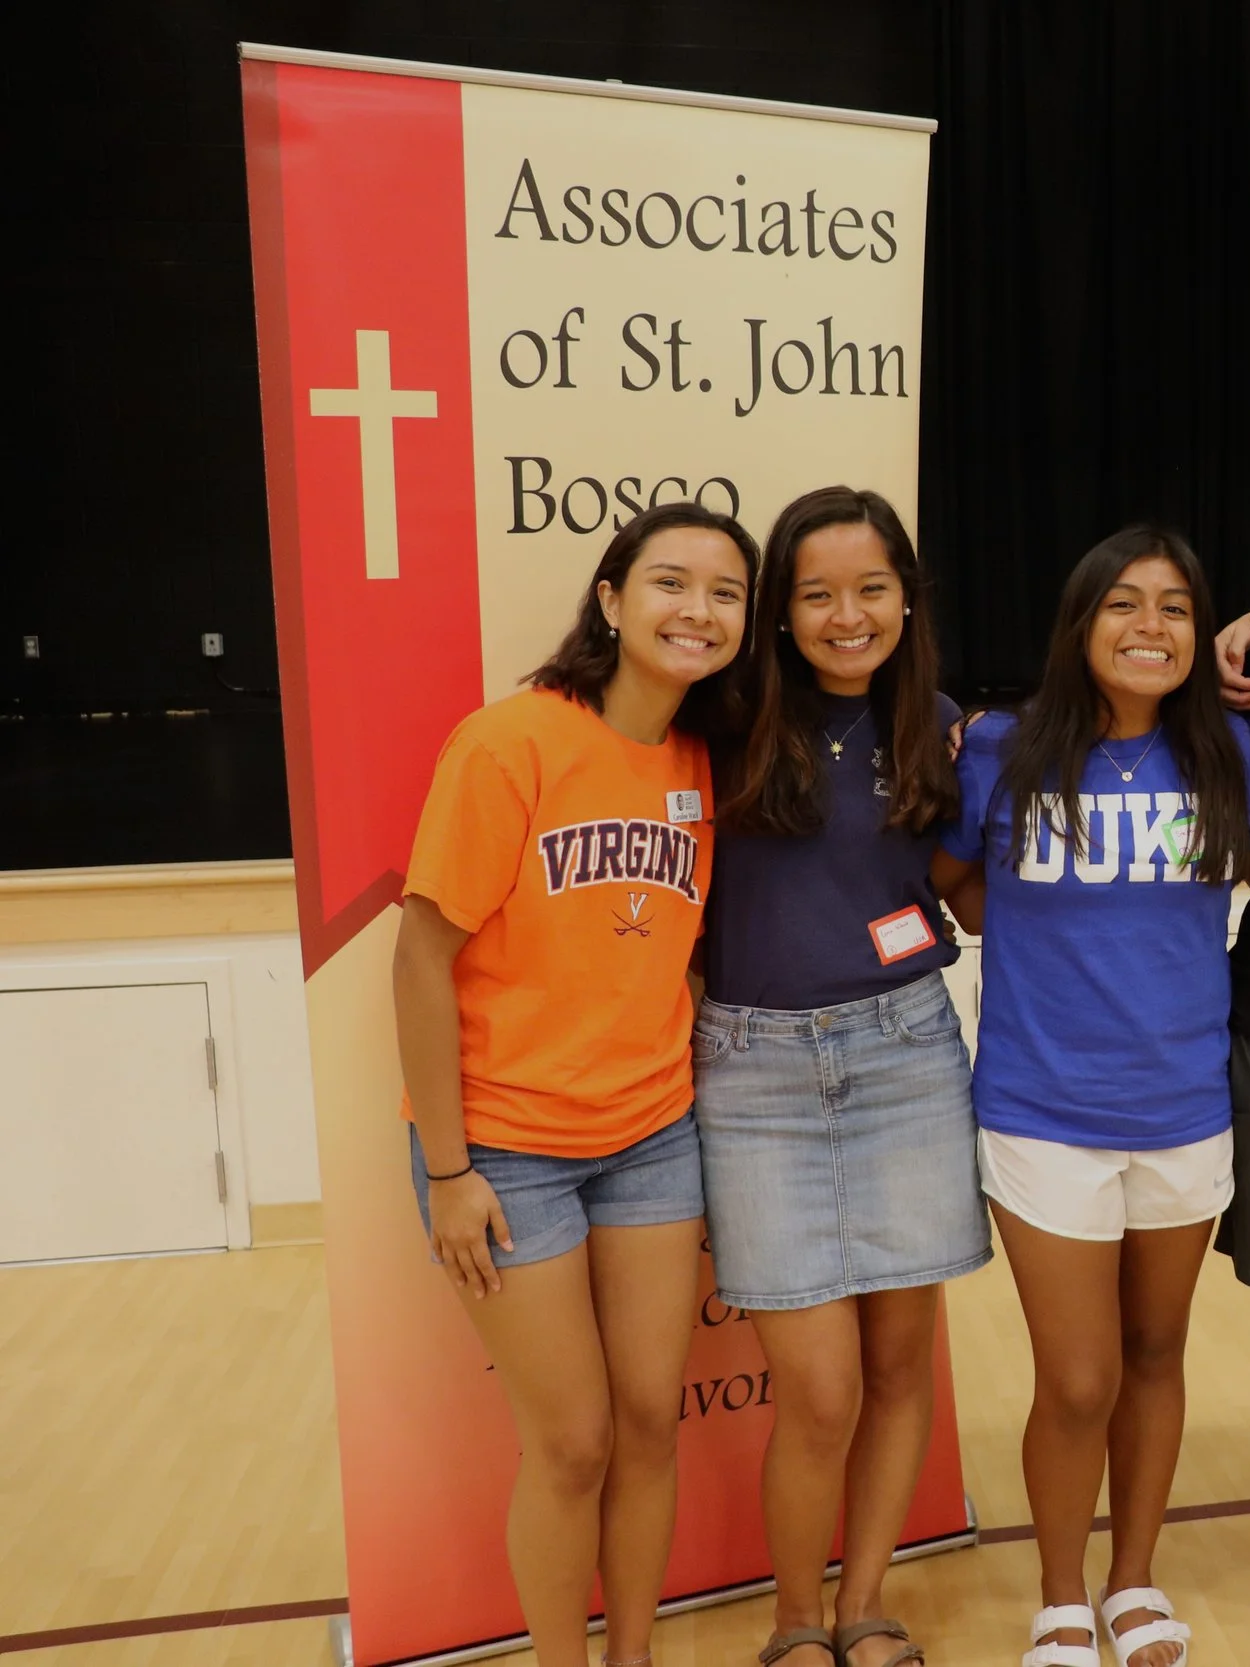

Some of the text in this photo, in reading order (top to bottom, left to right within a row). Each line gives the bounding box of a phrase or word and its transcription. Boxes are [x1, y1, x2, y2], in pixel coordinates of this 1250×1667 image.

[495, 158, 898, 264] Associates
[499, 307, 910, 418] of St. John
[538, 819, 703, 904] VIRGINI
[1019, 792, 1234, 883] DUK
